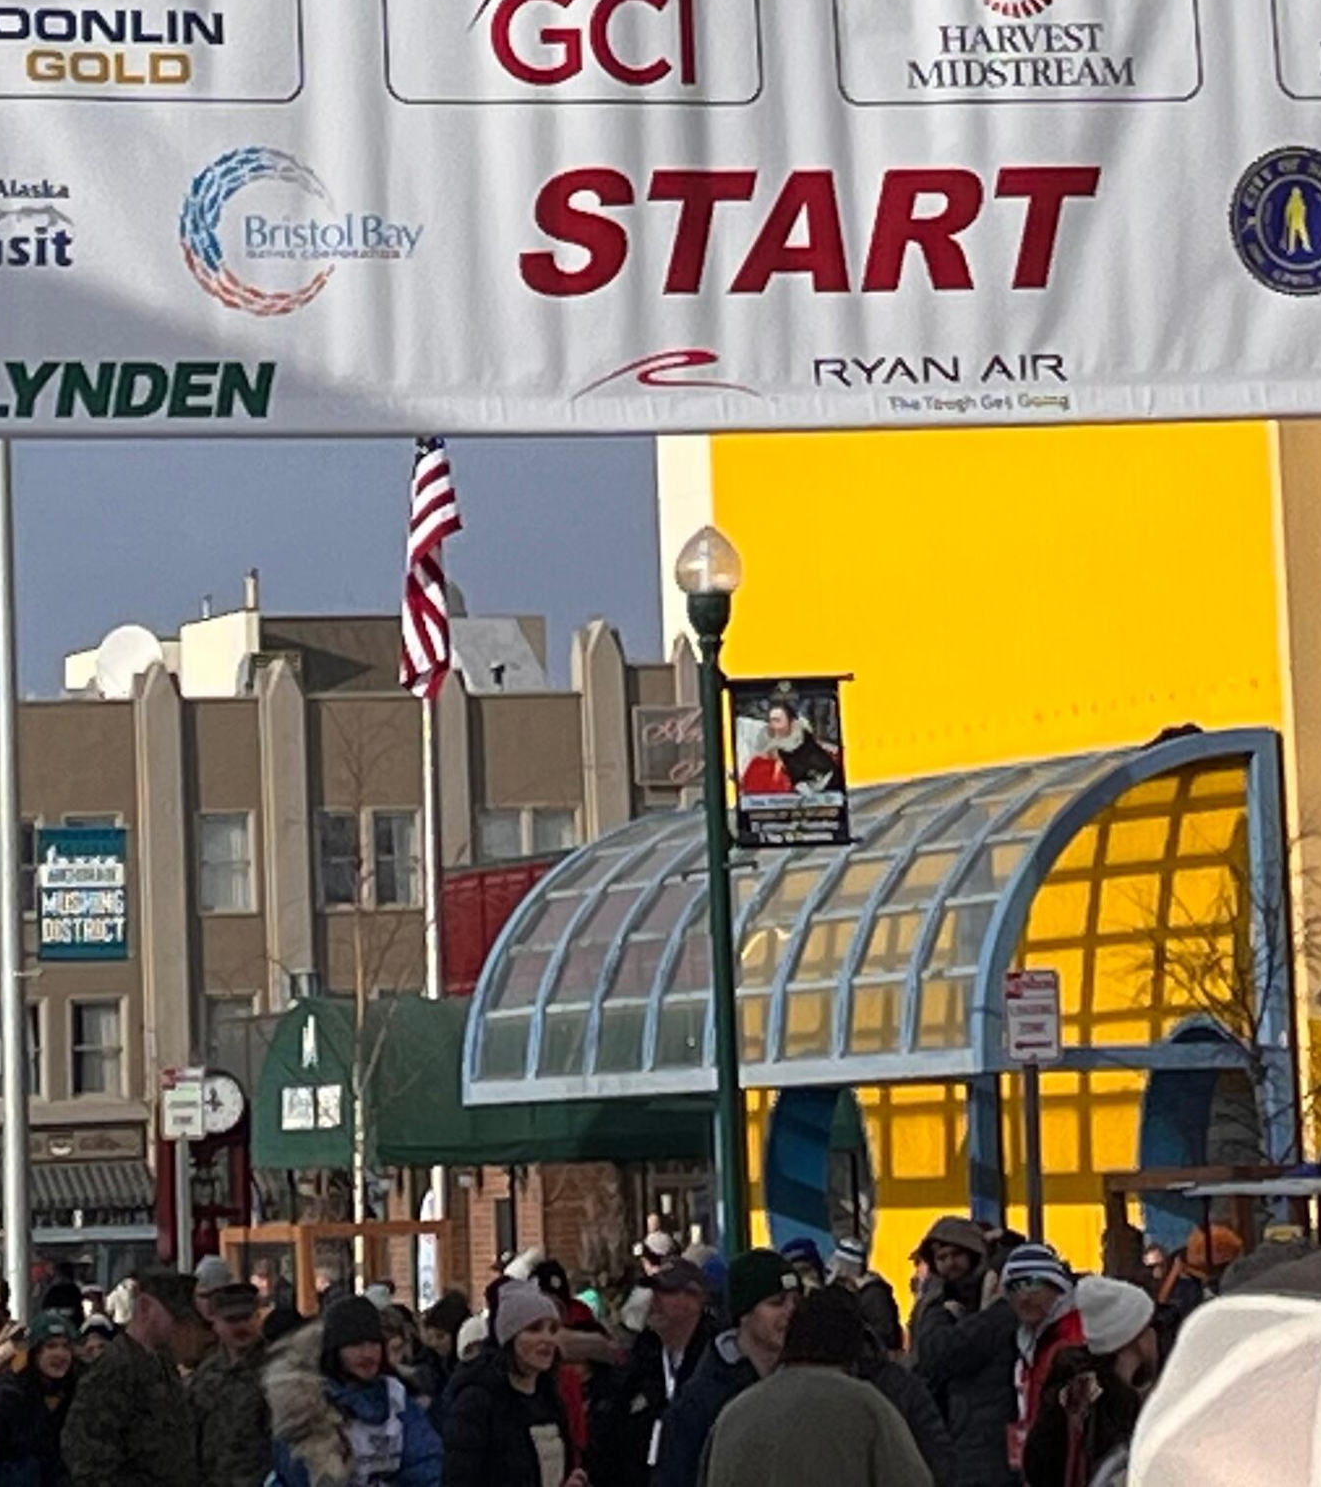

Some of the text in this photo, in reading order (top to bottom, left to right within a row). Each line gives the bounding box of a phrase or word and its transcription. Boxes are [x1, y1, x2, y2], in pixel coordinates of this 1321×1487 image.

[938, 23, 1105, 54] HARVEST
[25, 49, 193, 85] GOLD
[906, 56, 1137, 90] MIDSTREAM
[244, 213, 424, 258] Bristol Bay
[519, 167, 1102, 297] START
[814, 353, 1068, 386] RYAN AIR
